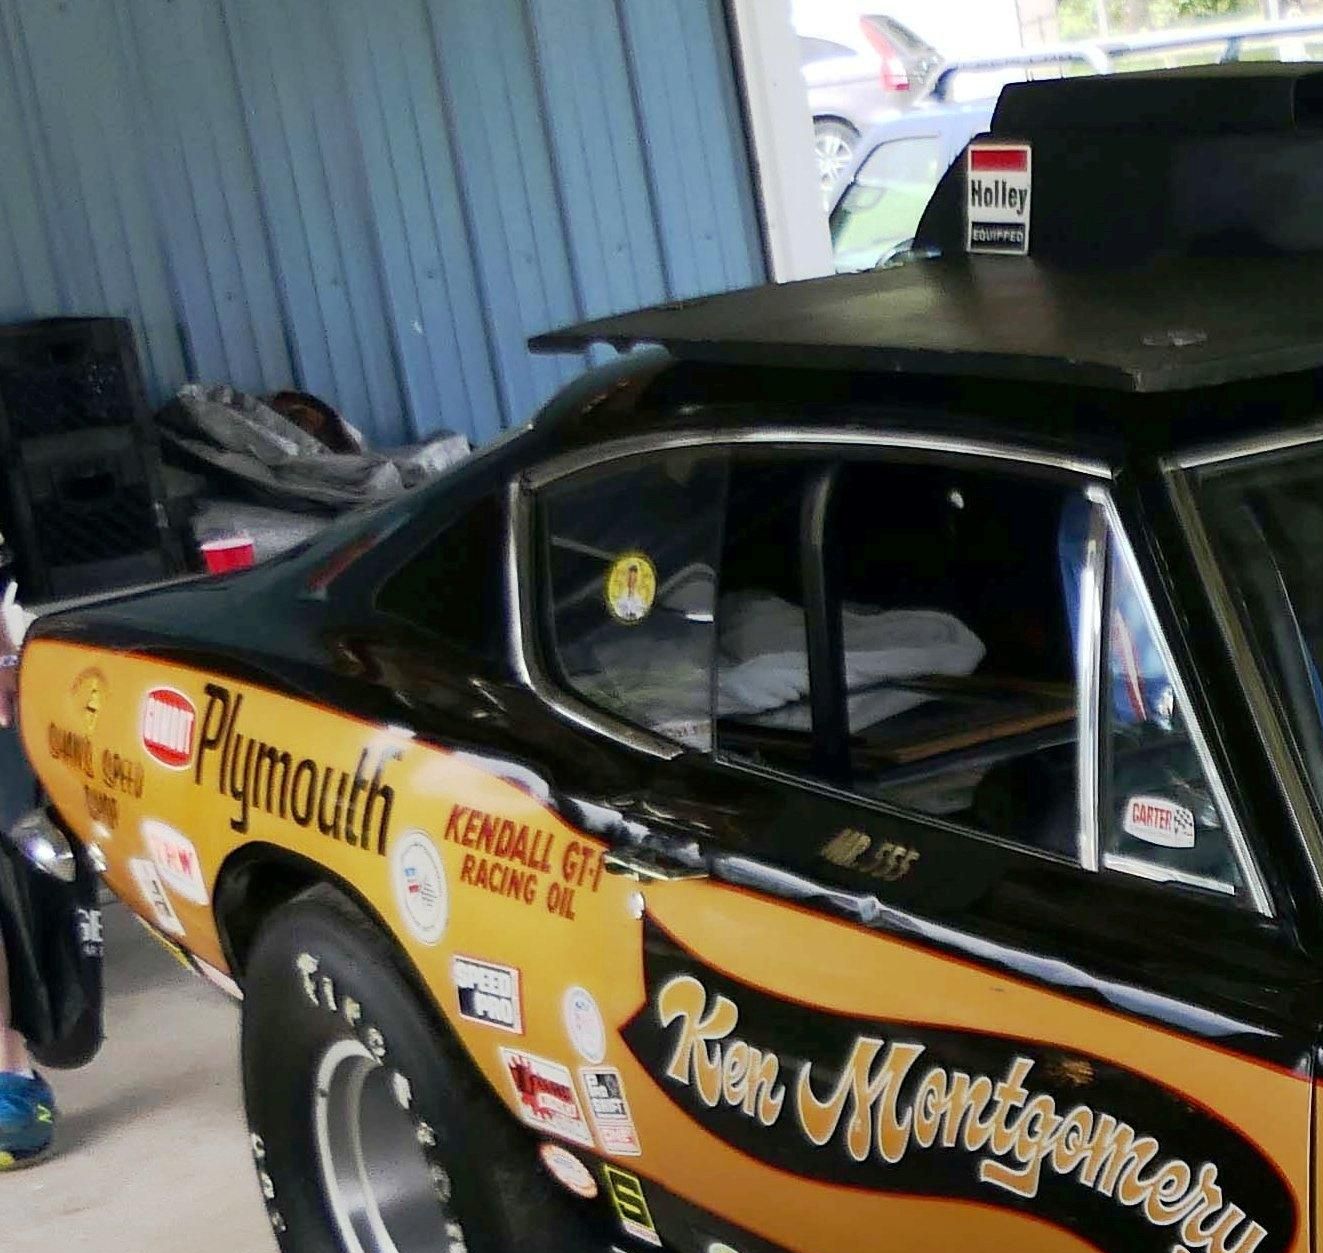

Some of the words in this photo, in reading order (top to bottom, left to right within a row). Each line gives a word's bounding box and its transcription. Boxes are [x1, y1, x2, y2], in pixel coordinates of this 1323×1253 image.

[971, 179, 1028, 215] Holley
[972, 225, 1024, 243] EQUIPPED
[195, 682, 397, 857] Plymouth
[444, 803, 555, 873] KENDALL
[1131, 802, 1173, 832] CARTER
[459, 854, 538, 905] RACING
[546, 881, 577, 921] OIL
[657, 974, 786, 1127] Ken
